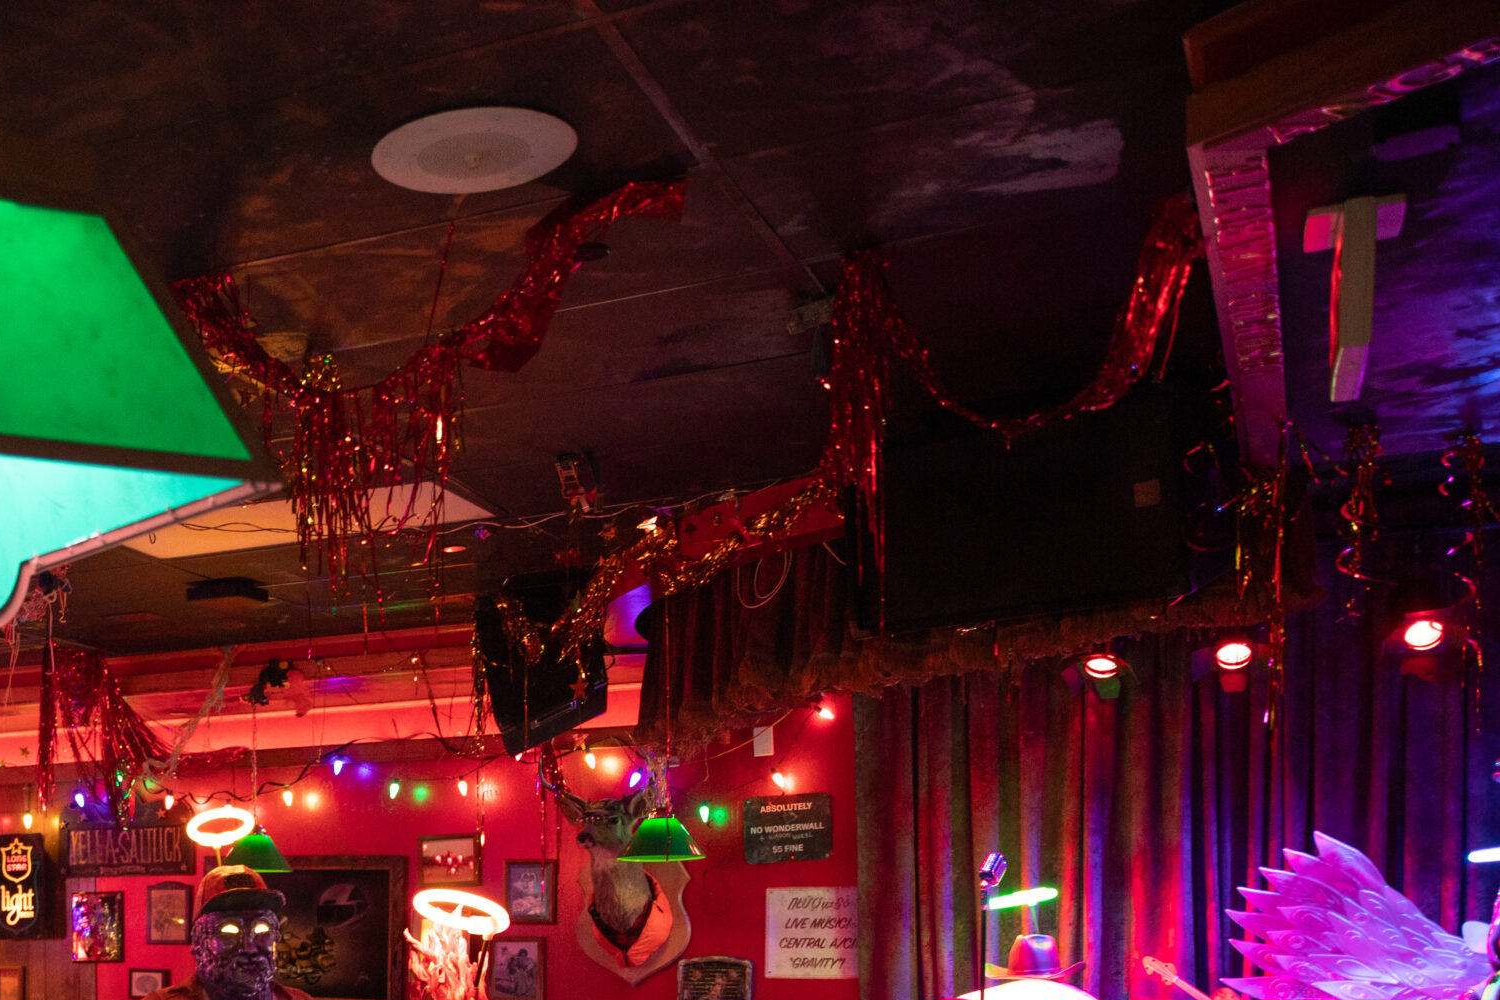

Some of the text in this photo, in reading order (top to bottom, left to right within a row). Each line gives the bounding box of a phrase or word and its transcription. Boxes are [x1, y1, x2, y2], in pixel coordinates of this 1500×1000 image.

[760, 802, 813, 813] ABSOLUTELY
[750, 821, 825, 835] NO WONDERWALL
[772, 844, 804, 854] $5 FINE
[6, 854, 27, 863] LONE
[6, 863, 28, 872] STAR
[0, 884, 35, 926] light
[784, 918, 807, 929] LIVE
[779, 937, 826, 949] CENTRAL
